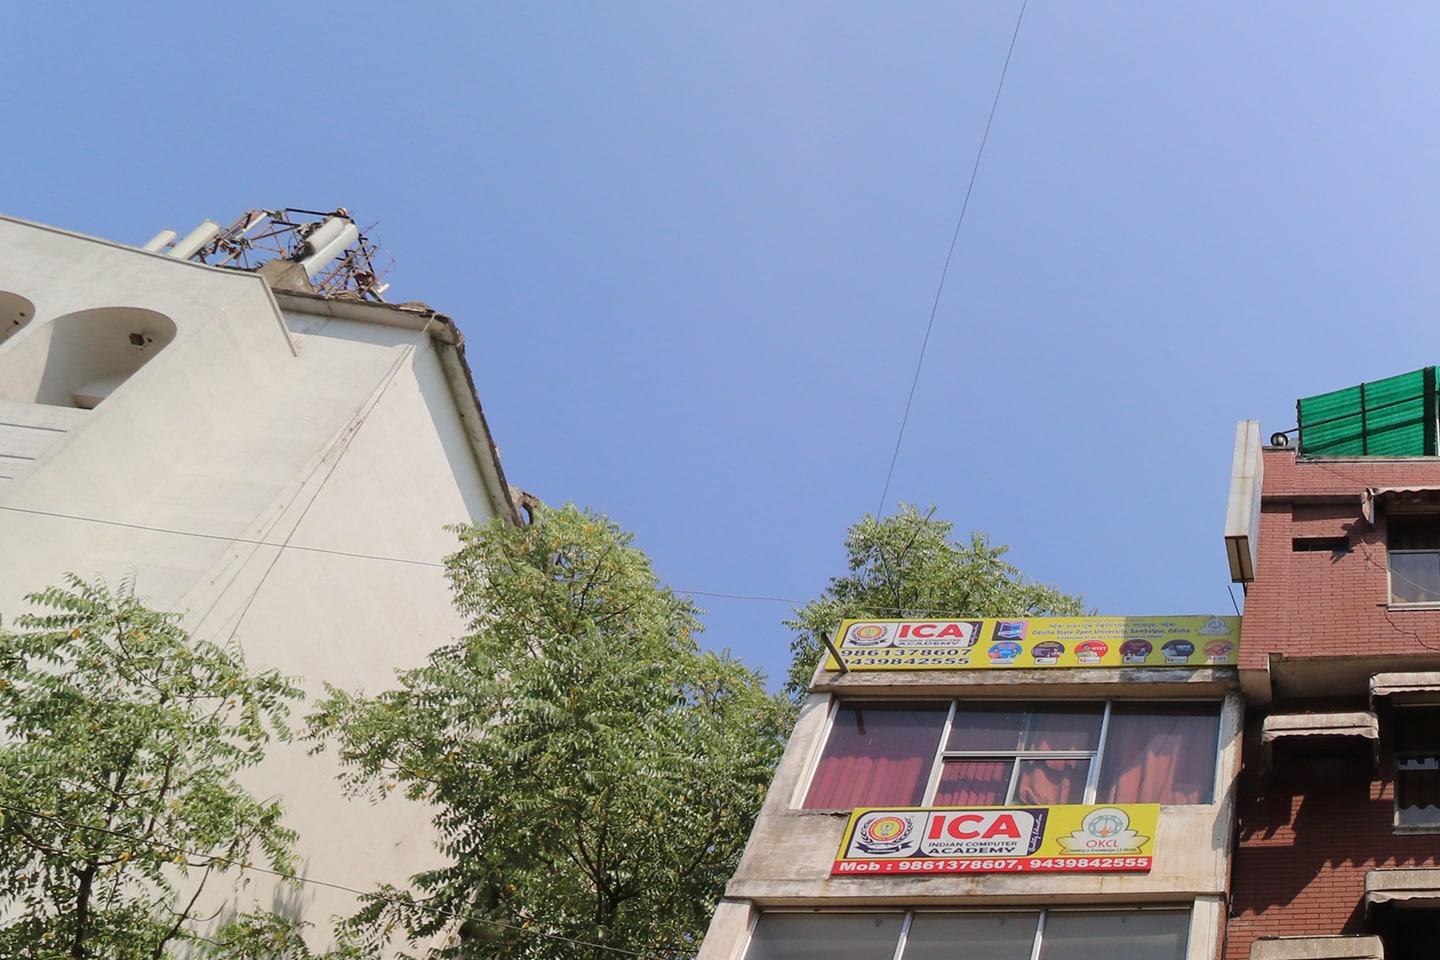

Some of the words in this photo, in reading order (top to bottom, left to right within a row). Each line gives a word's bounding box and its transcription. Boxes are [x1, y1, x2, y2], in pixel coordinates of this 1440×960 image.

[898, 624, 964, 638] ICA
[927, 814, 1021, 840] ICA
[1086, 839, 1119, 848] OKCL
[928, 847, 1015, 855] ACADEMY
[839, 862, 881, 871] Mob
[899, 860, 1023, 871] 9861378607,
[1030, 858, 1148, 868] 9439842555
